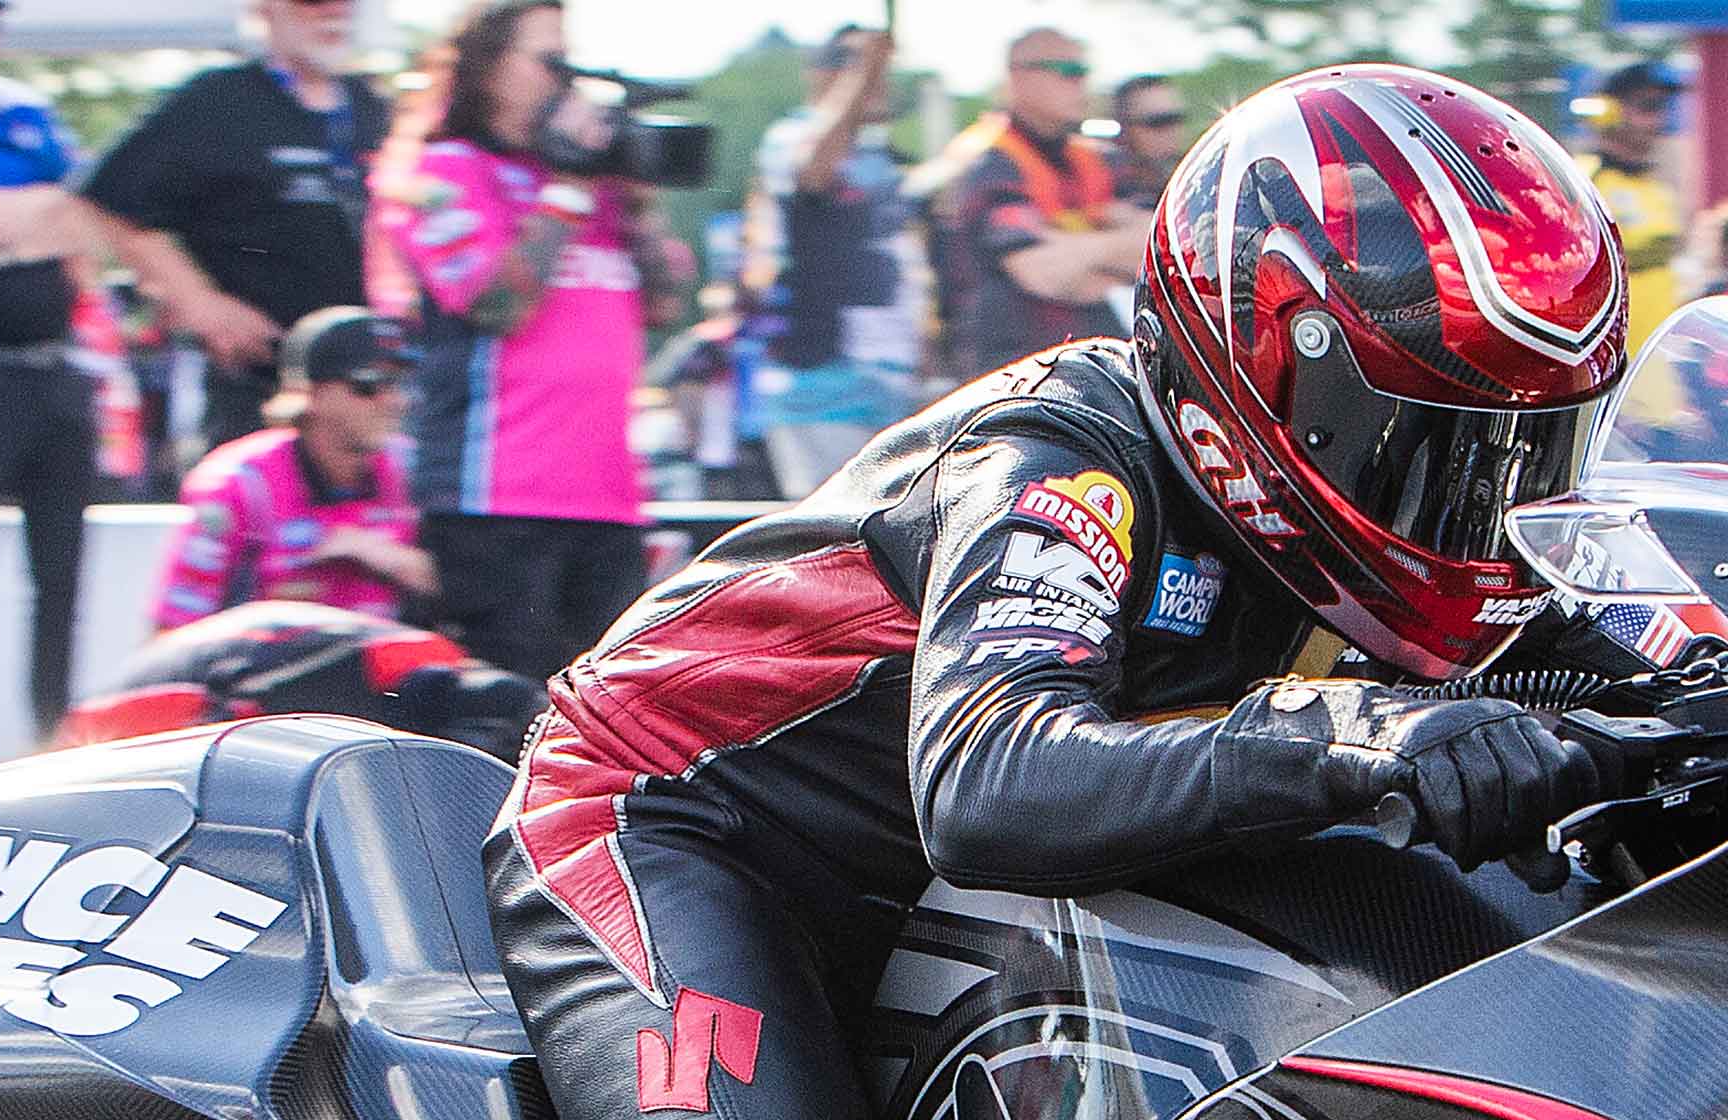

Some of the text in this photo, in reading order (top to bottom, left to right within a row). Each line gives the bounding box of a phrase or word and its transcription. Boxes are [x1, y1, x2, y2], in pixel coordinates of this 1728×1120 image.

[1022, 488, 1130, 590] MISSION
[991, 575, 1107, 618] AIR INTAK
[1158, 589, 1214, 623] WORL
